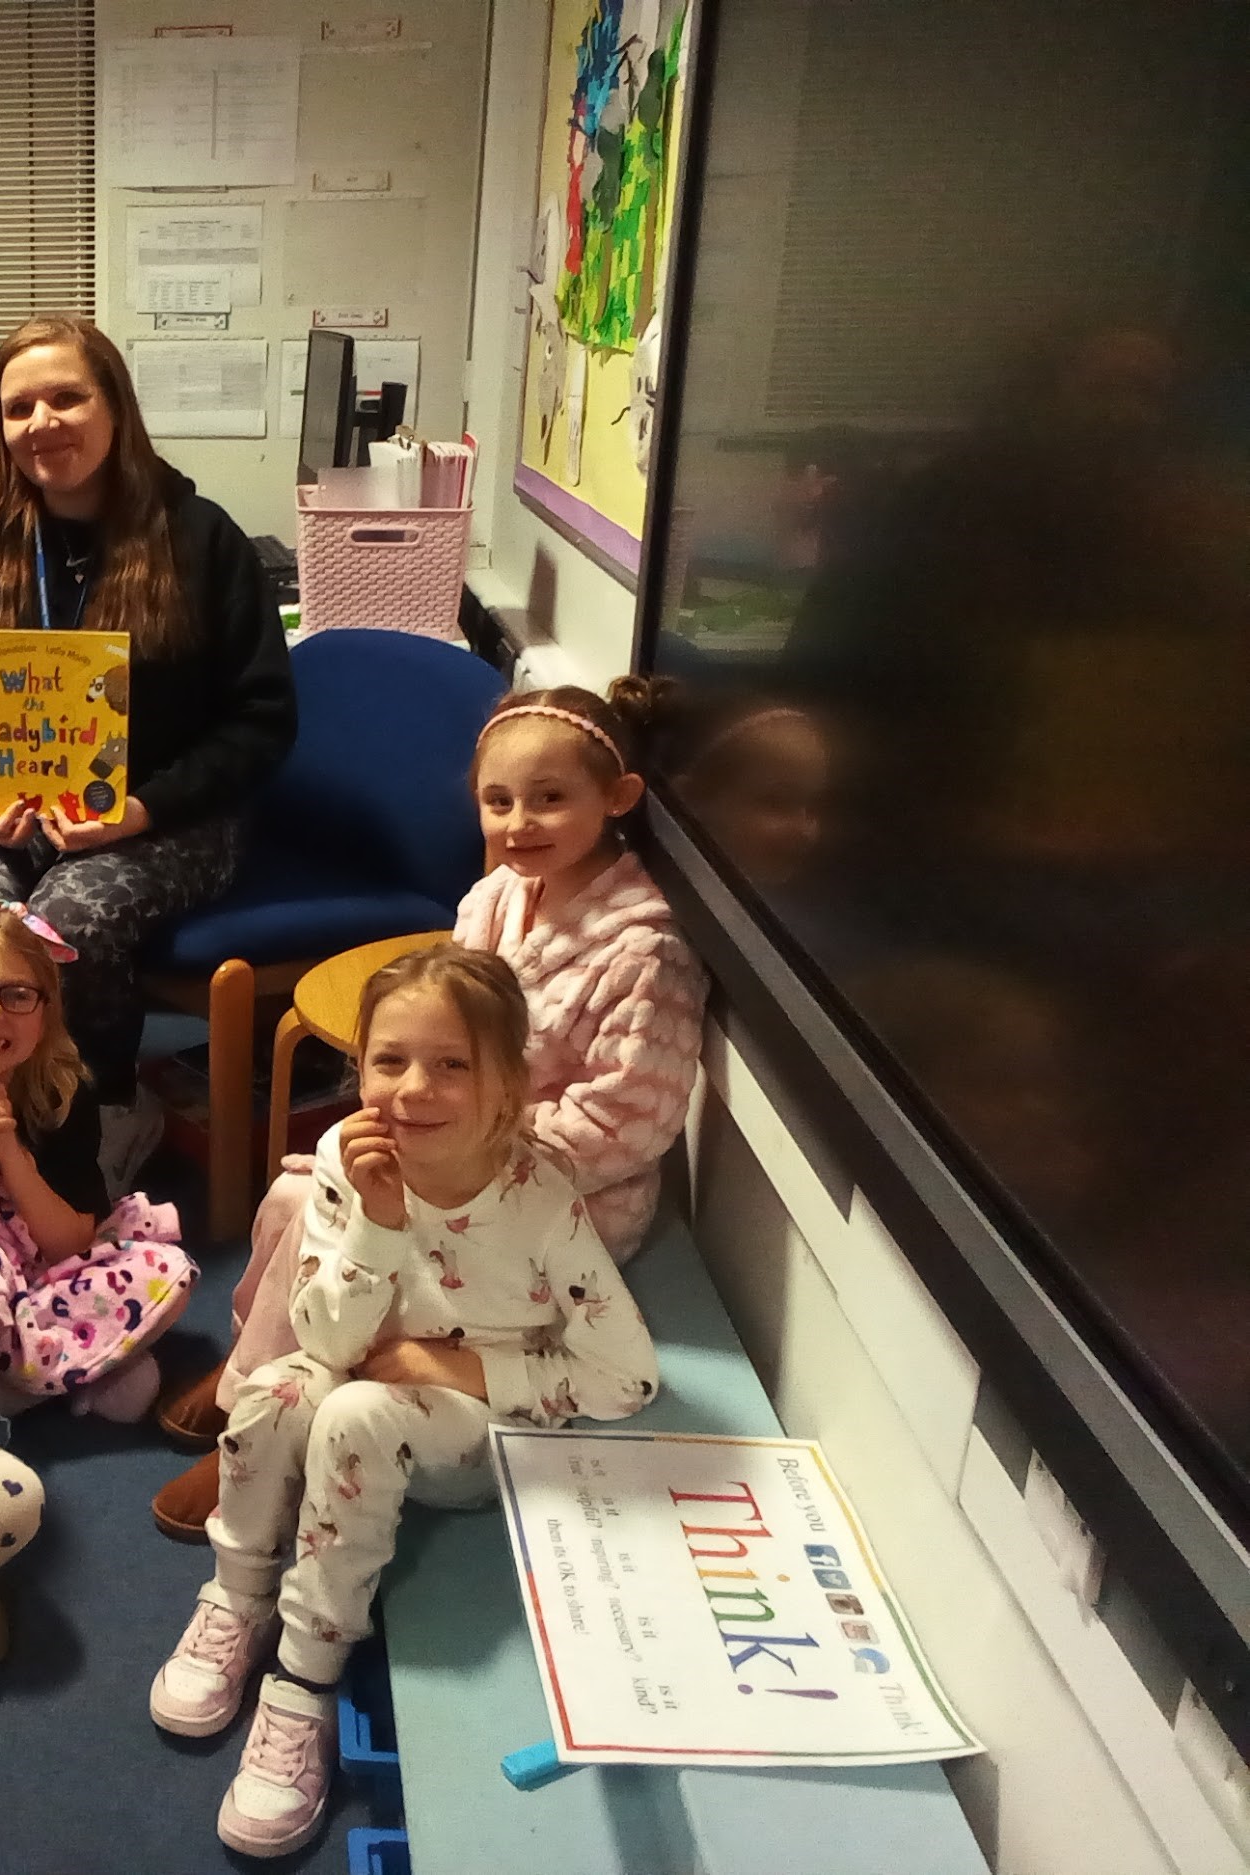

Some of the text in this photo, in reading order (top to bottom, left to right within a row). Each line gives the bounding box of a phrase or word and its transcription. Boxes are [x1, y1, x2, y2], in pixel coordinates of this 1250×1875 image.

[0, 661, 64, 695] What
[22, 696, 45, 711] the
[776, 1458, 811, 1500] Before
[796, 1504, 826, 1532] you
[546, 1519, 593, 1636] then its OK to share!
[589, 1536, 620, 1590] nspiring?
[608, 1597, 644, 1663] necessary?
[630, 1676, 659, 1714] kind?
[668, 1481, 839, 1702] Think!
